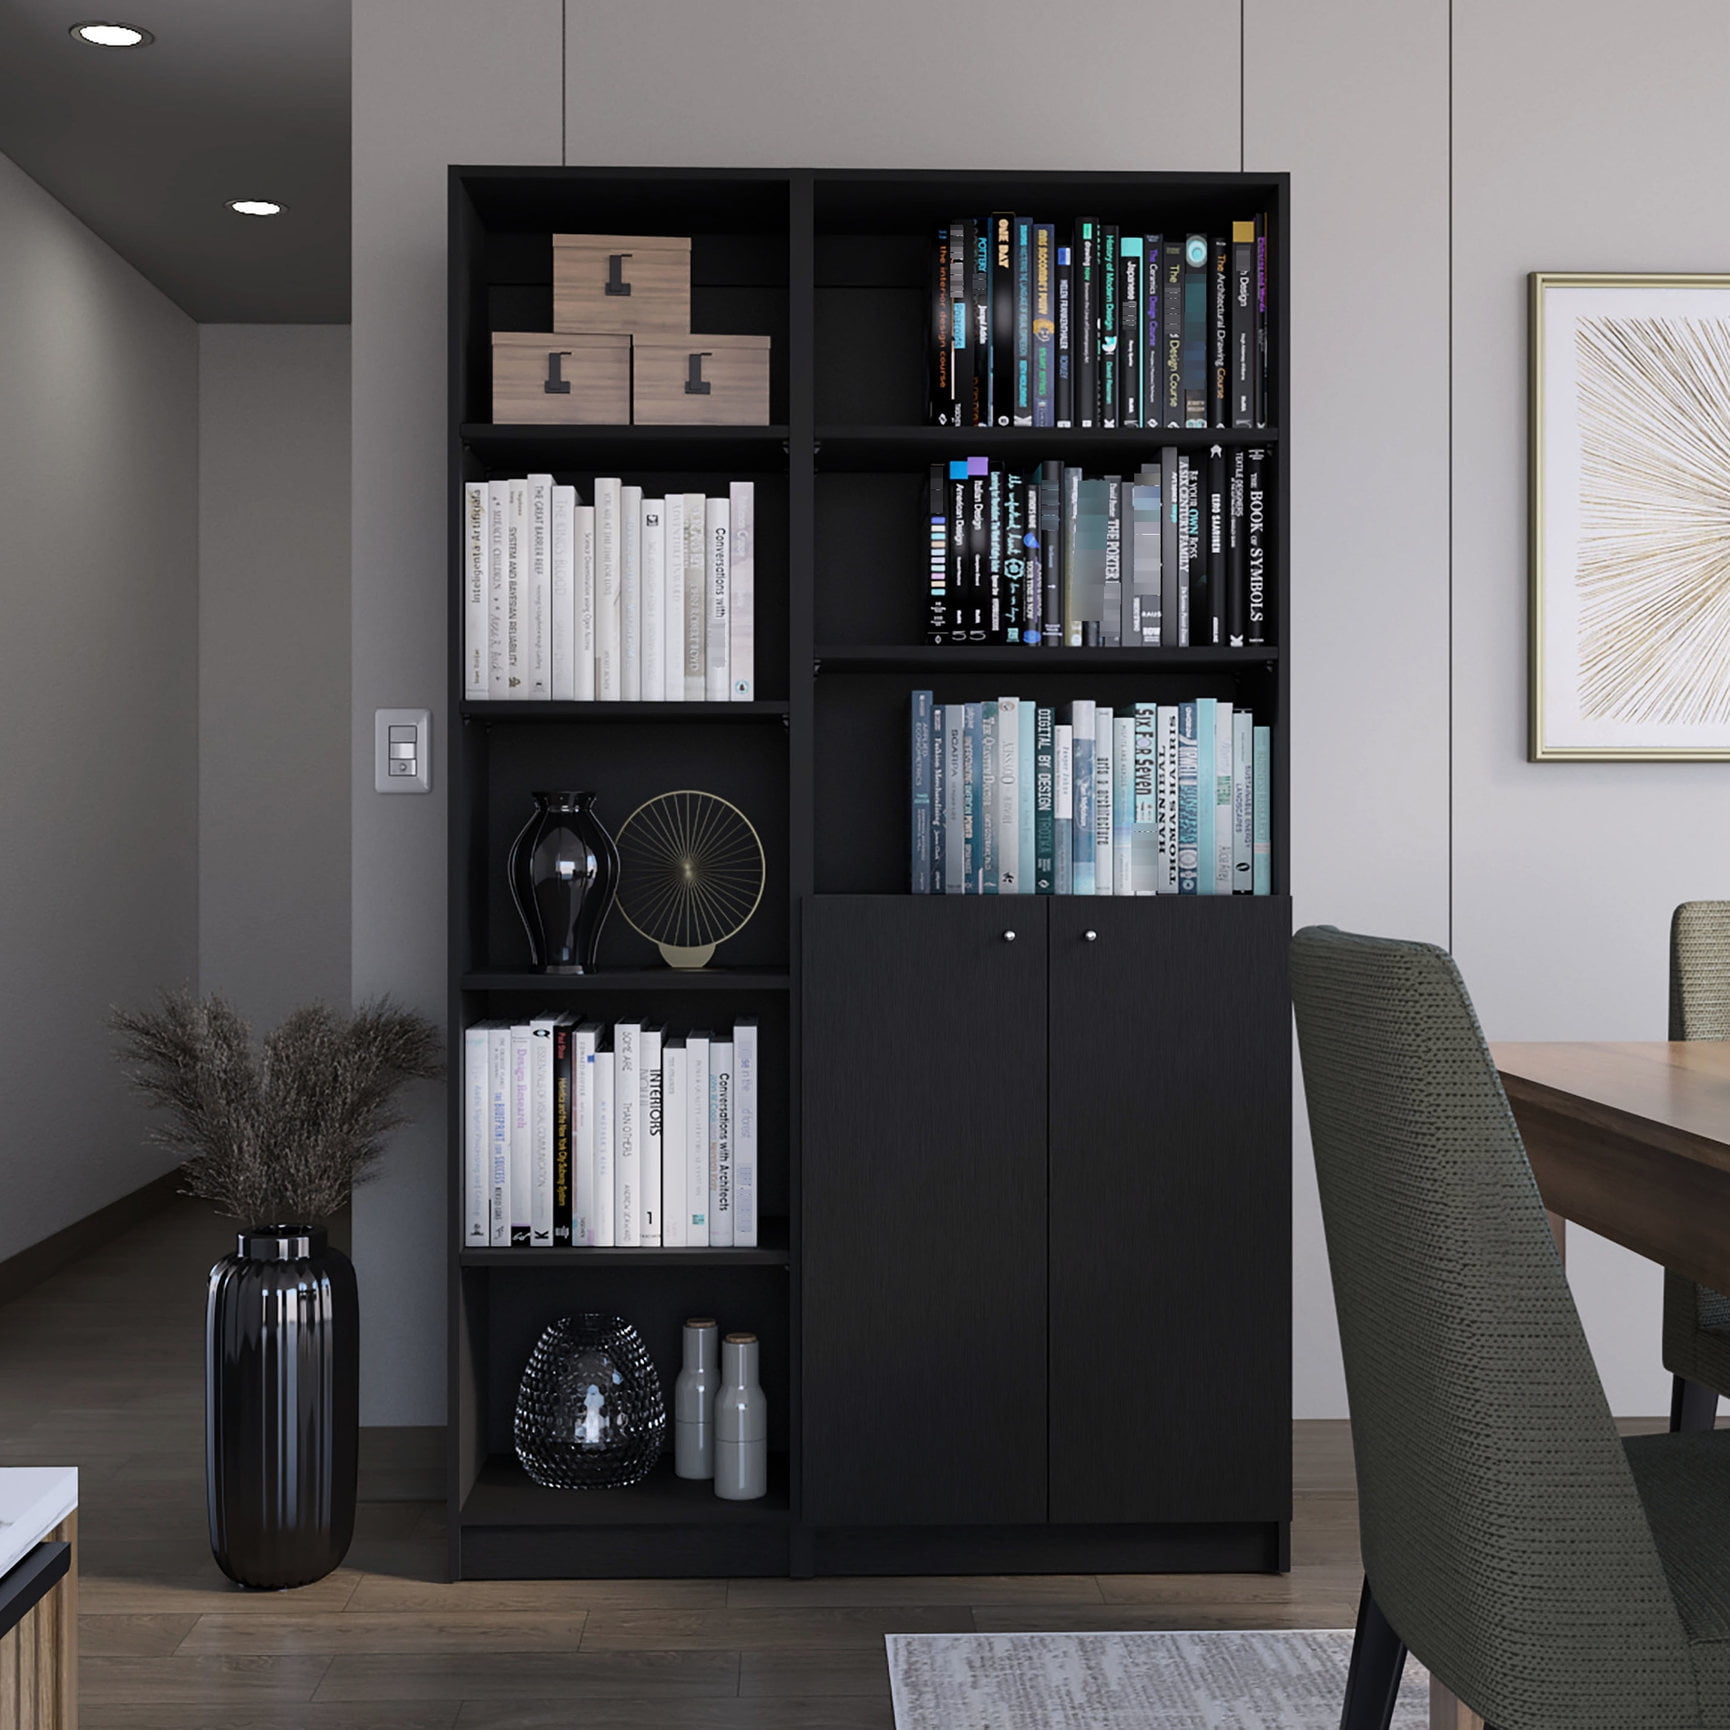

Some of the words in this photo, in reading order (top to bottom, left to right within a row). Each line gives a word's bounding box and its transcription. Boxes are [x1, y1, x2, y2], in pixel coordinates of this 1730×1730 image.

[998, 218, 1010, 243] ONE
[977, 237, 988, 273] POTTERY
[998, 243, 1010, 269] DAY
[1082, 240, 1093, 267] drawing
[1104, 235, 1114, 262] History
[1149, 249, 1158, 263] The
[1217, 254, 1226, 272] The
[1104, 262, 1114, 272] of
[1125, 261, 1137, 300] Japanese
[1149, 263, 1158, 295] Ceramics
[1169, 264, 1180, 283] The
[939, 266, 948, 309] interior
[1106, 273, 1114, 303] Modern
[1217, 272, 1226, 329] Architectural
[1237, 277, 1249, 307] Design
[1104, 303, 1114, 331] Design
[1147, 296, 1158, 319] Design
[937, 310, 948, 348] design
[1149, 320, 1158, 346] Course
[1167, 340, 1180, 372] Design
[1214, 329, 1226, 367] Drawing
[939, 350, 947, 389] course
[1217, 367, 1226, 400] Course
[1169, 372, 1180, 408] Course
[1179, 460, 1189, 470] A
[1179, 469, 1189, 487] SIX
[1235, 451, 1244, 478] TEXTILE
[534, 485, 544, 499] THE
[973, 479, 984, 503] Italian
[1250, 472, 1258, 489] THE
[534, 500, 544, 524] GREAT
[955, 483, 965, 520] American
[1179, 486, 1189, 535] CENTURY
[1234, 478, 1244, 518] DESIGNERS
[1250, 490, 1264, 533] BOOK
[971, 503, 984, 531] Design
[1107, 518, 1120, 540] THE
[1189, 507, 1199, 535] OWN
[508, 526, 517, 560] SYSTEM
[534, 526, 544, 557] BARRIER
[954, 520, 965, 547] Design
[1250, 534, 1258, 547] OF
[714, 527, 726, 596] Conversations
[1105, 540, 1120, 581] PORTER
[1179, 535, 1189, 573] FAMILY
[508, 560, 517, 579] AND
[1250, 547, 1264, 622] SYMBOLS
[508, 580, 517, 620] BAYESIAN
[714, 597, 726, 619] with
[508, 620, 517, 667] RELIABILITY
[1037, 708, 1052, 750] DIGITAL
[934, 737, 943, 768] Fashion
[951, 729, 959, 778] SCARPA
[1037, 754, 1052, 768] BY
[1096, 757, 1111, 775] arts
[1168, 715, 1177, 798] HARRIS
[932, 769, 943, 826] Merchandising
[1037, 773, 1052, 811] DESIGN
[1158, 744, 1167, 855] HANNIBAL
[1244, 764, 1252, 817] SUSTAINABLE
[1235, 782, 1243, 834] LANDSCAPES
[1037, 817, 1051, 853] TROIKA
[1168, 800, 1177, 886] THOMAS
[1244, 818, 1252, 849] ENERGY
[557, 1031, 566, 1043] Paul
[557, 1043, 566, 1060] Shaw
[621, 1031, 633, 1054] SOME
[514, 1048, 527, 1081] Design
[537, 1045, 547, 1089] ESSENTIALS
[621, 1055, 633, 1072] ARE
[537, 1088, 547, 1098] OF
[557, 1077, 567, 1103] Helvetica
[648, 1068, 661, 1137] INTERIORS
[516, 1084, 527, 1129] Research
[537, 1099, 547, 1127] VISUAL
[557, 1102, 567, 1115] and
[557, 1114, 567, 1125] the
[621, 1102, 633, 1126] THAN
[718, 1072, 730, 1140] Conversations
[494, 1102, 506, 1142] BLUEPRINT
[557, 1124, 567, 1138] New
[556, 1150, 567, 1163] City
[557, 1137, 567, 1151] York
[621, 1126, 633, 1157] OTHERS
[718, 1141, 730, 1162] with
[494, 1155, 506, 1185] SUCCESS
[537, 1127, 547, 1188] COMMUNICATION
[556, 1162, 567, 1186] Subway
[718, 1164, 730, 1212] Architects
[556, 1185, 567, 1207] System
